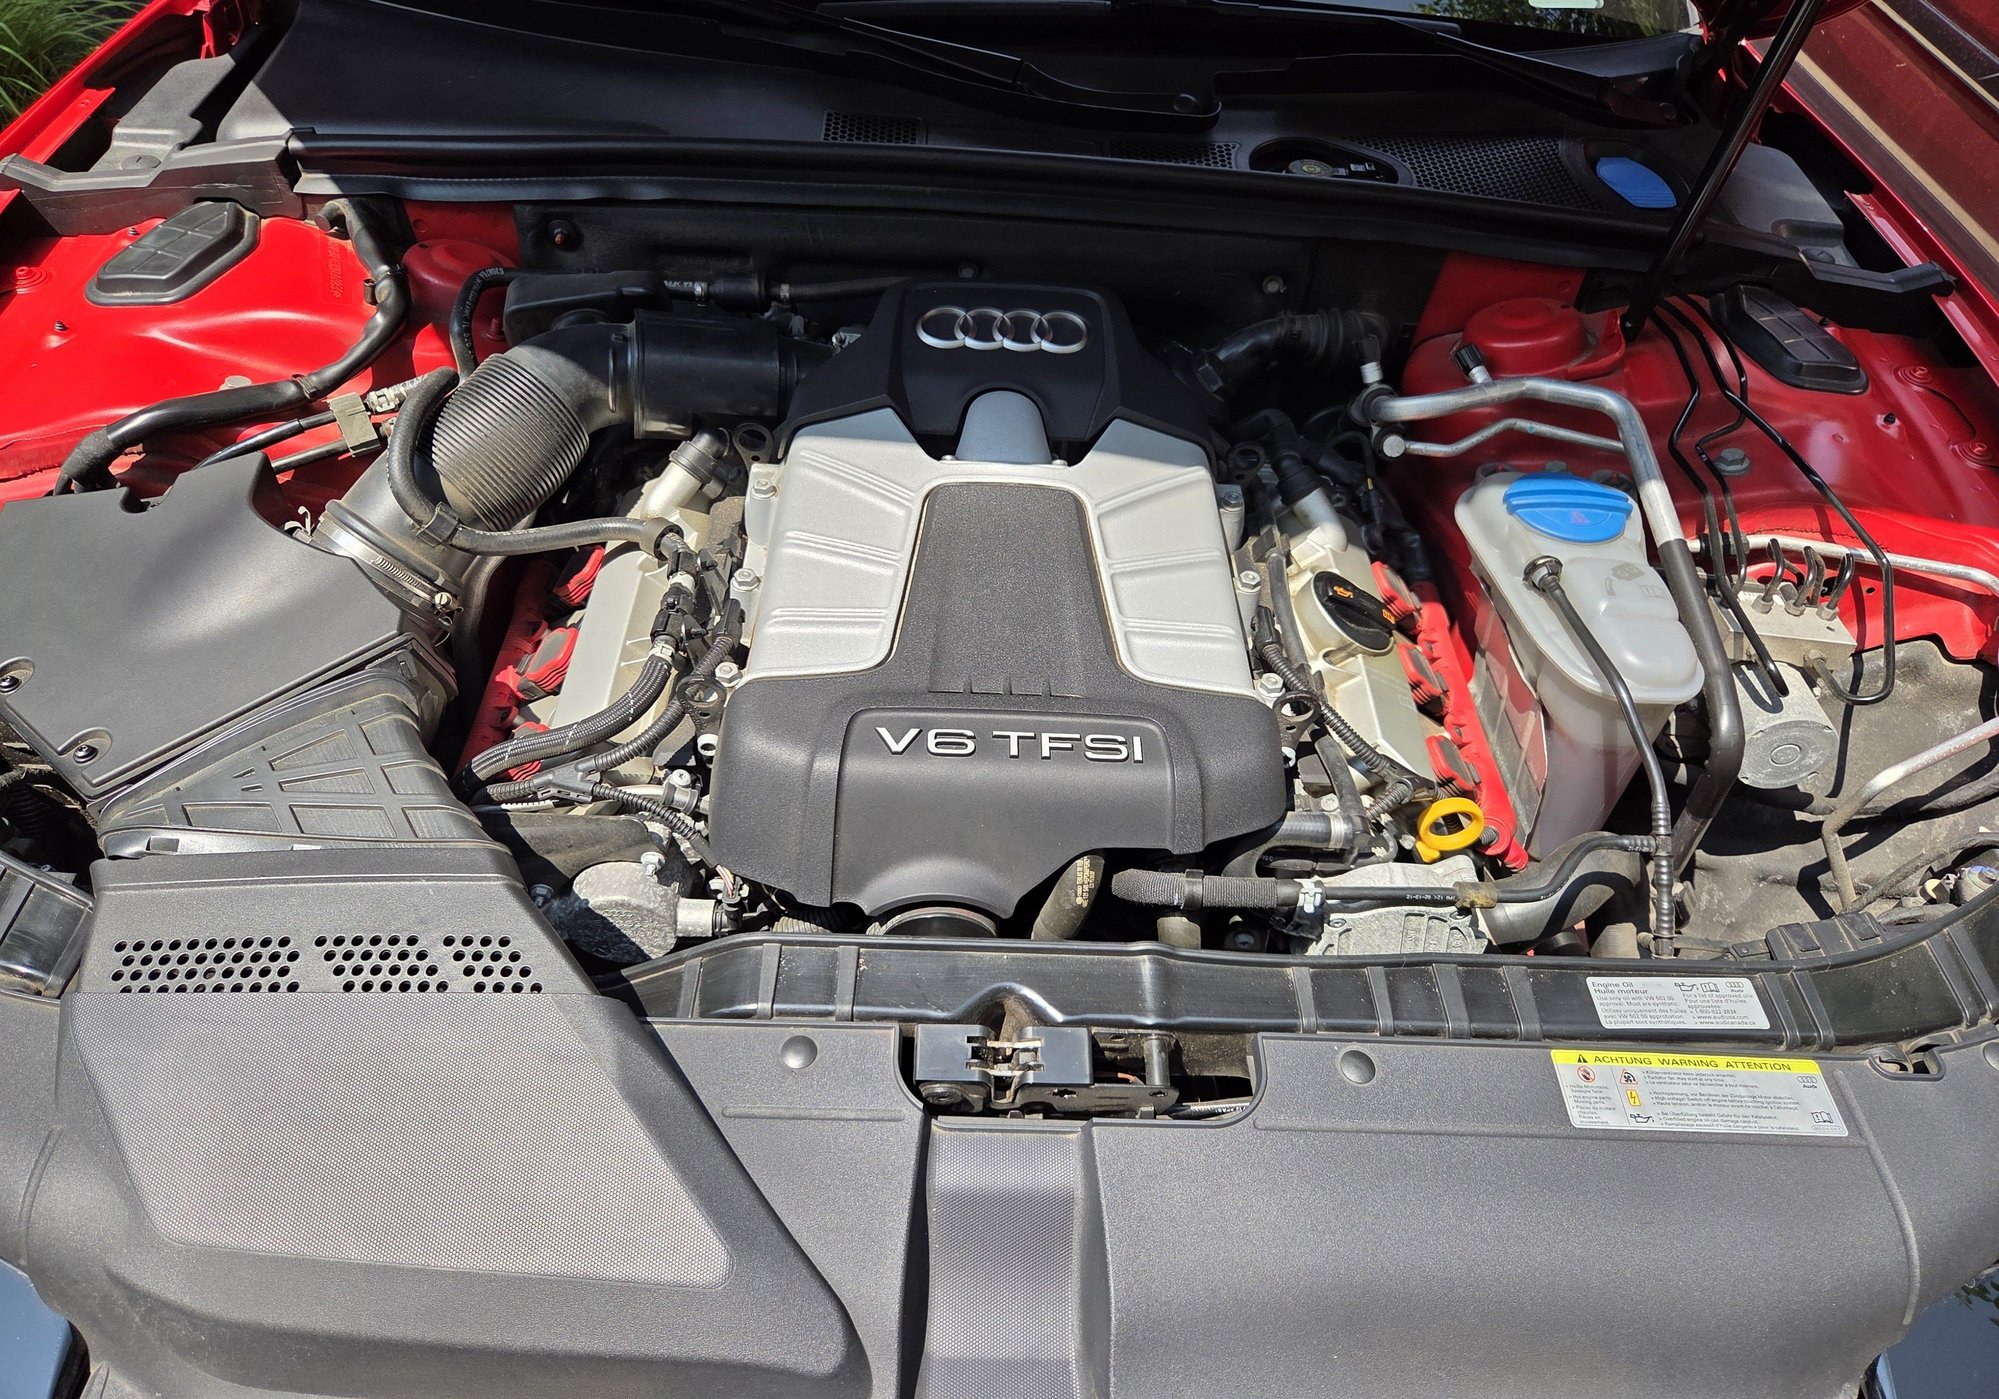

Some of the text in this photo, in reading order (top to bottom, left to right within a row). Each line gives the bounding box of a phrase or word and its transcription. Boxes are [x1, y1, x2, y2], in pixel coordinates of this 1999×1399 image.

[875, 727, 1144, 764] V6 TFSI
[1594, 1056, 1791, 1071] ACHTUNG WARNING ATTENTION
